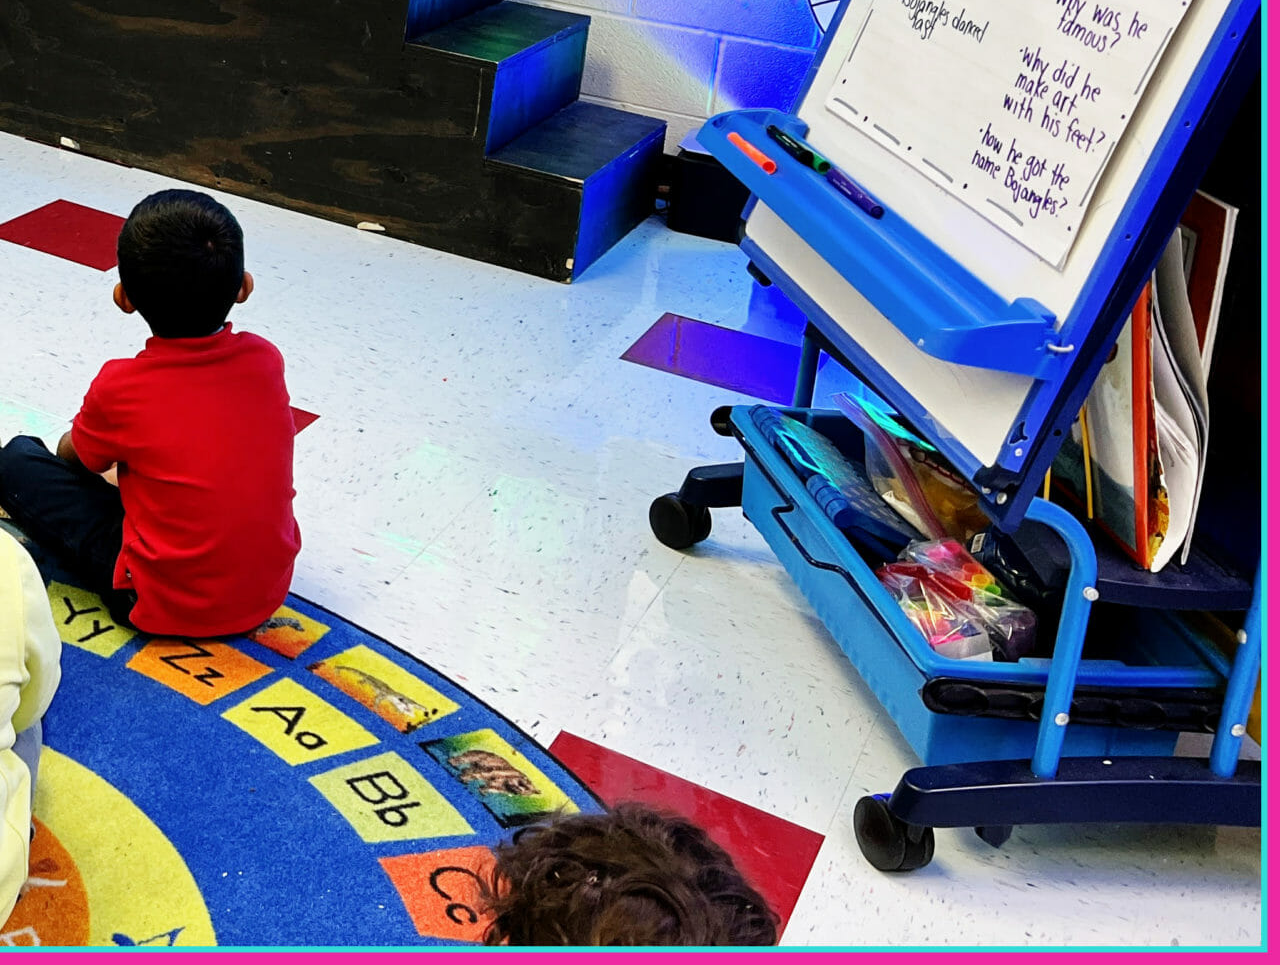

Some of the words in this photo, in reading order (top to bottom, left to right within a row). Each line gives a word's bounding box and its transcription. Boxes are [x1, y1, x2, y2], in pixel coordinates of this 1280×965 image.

[951, 8, 990, 44] danced
[1092, 4, 1122, 32] was
[1128, 11, 1149, 39] he
[1014, 73, 1049, 99] make
[1052, 90, 1079, 116] art
[1052, 59, 1080, 89] did
[1080, 73, 1101, 102] he
[1003, 94, 1034, 123] with
[1040, 105, 1062, 138] his
[1065, 117, 1106, 153] feet?
[971, 149, 1001, 179] name
[981, 123, 1003, 154] how
[1006, 138, 1023, 165] he
[1022, 155, 1048, 182] got
[1050, 163, 1071, 191] the
[251, 705, 329, 751] Aa
[346, 770, 422, 829] Bb
[428, 865, 479, 927] Cc
